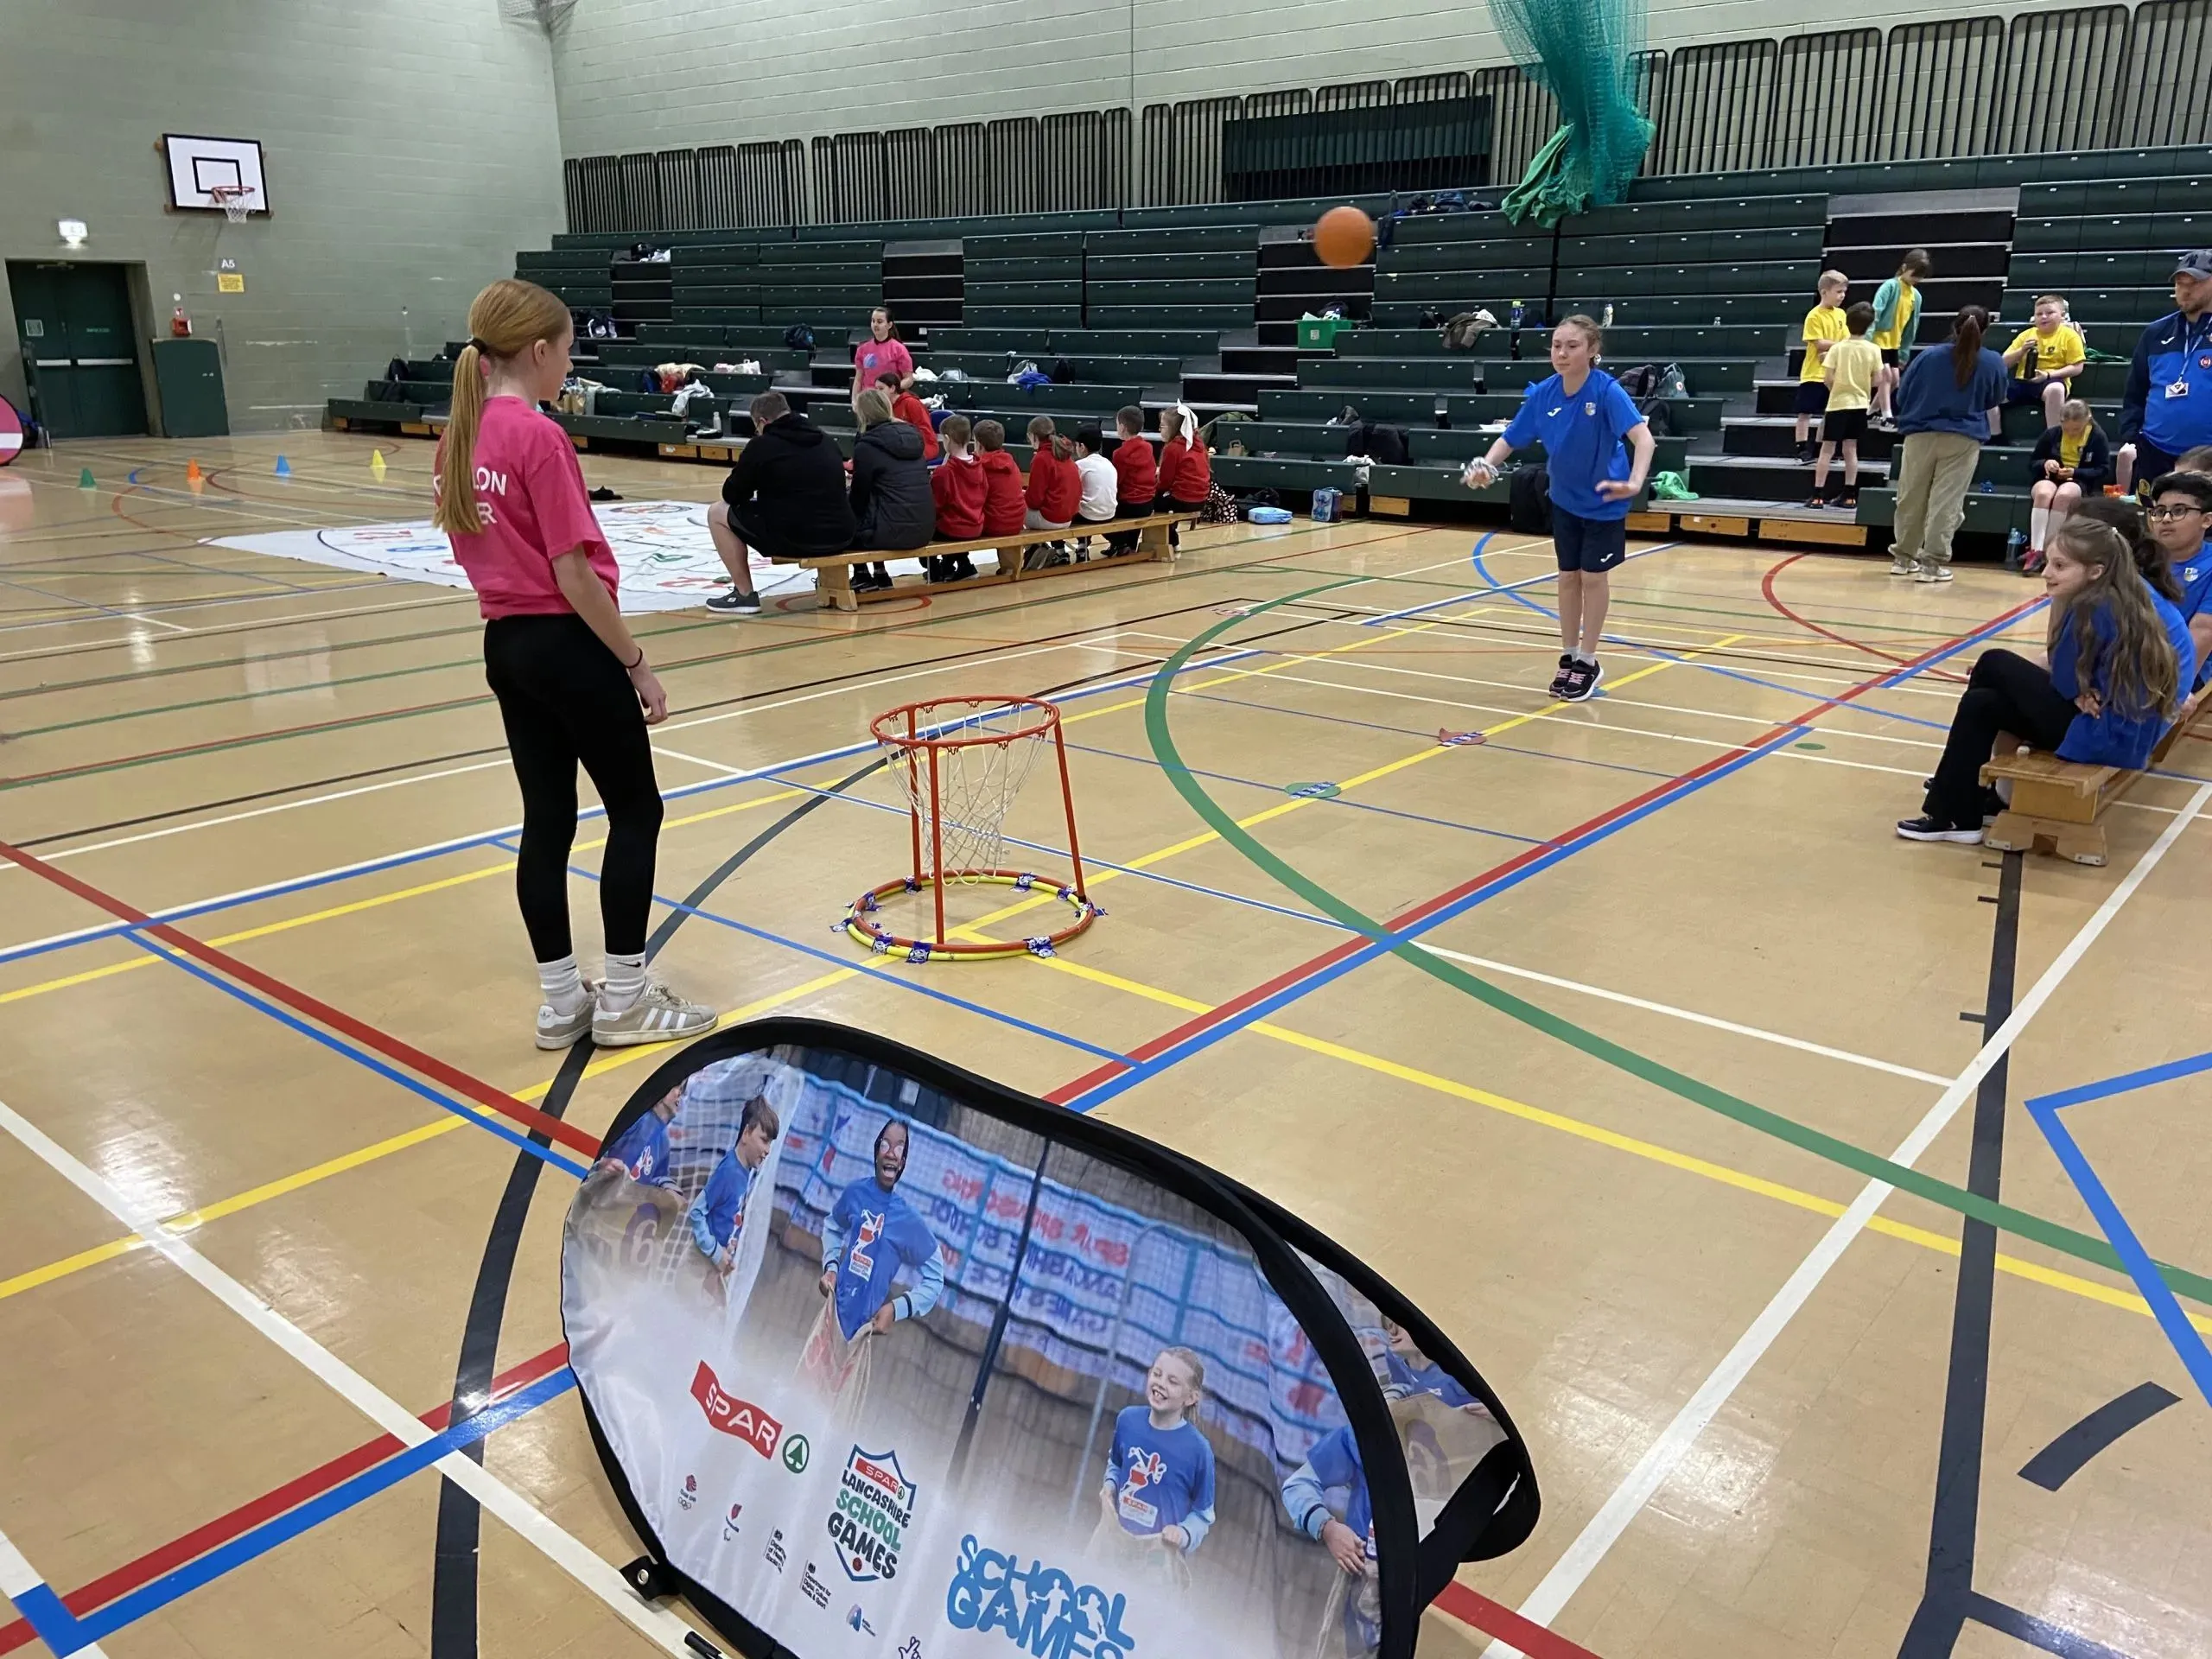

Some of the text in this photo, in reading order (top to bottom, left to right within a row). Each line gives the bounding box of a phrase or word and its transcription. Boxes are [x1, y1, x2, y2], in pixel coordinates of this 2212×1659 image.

[221, 258, 235, 269] A5
[706, 1382, 776, 1451] SPAR
[842, 1469, 911, 1529] LANCASHIRE
[865, 1465, 898, 1490] SPAR
[828, 1512, 898, 1580] GAMES
[836, 1488, 901, 1552] SCHOOL
[956, 1535, 1135, 1651] SCHOOL
